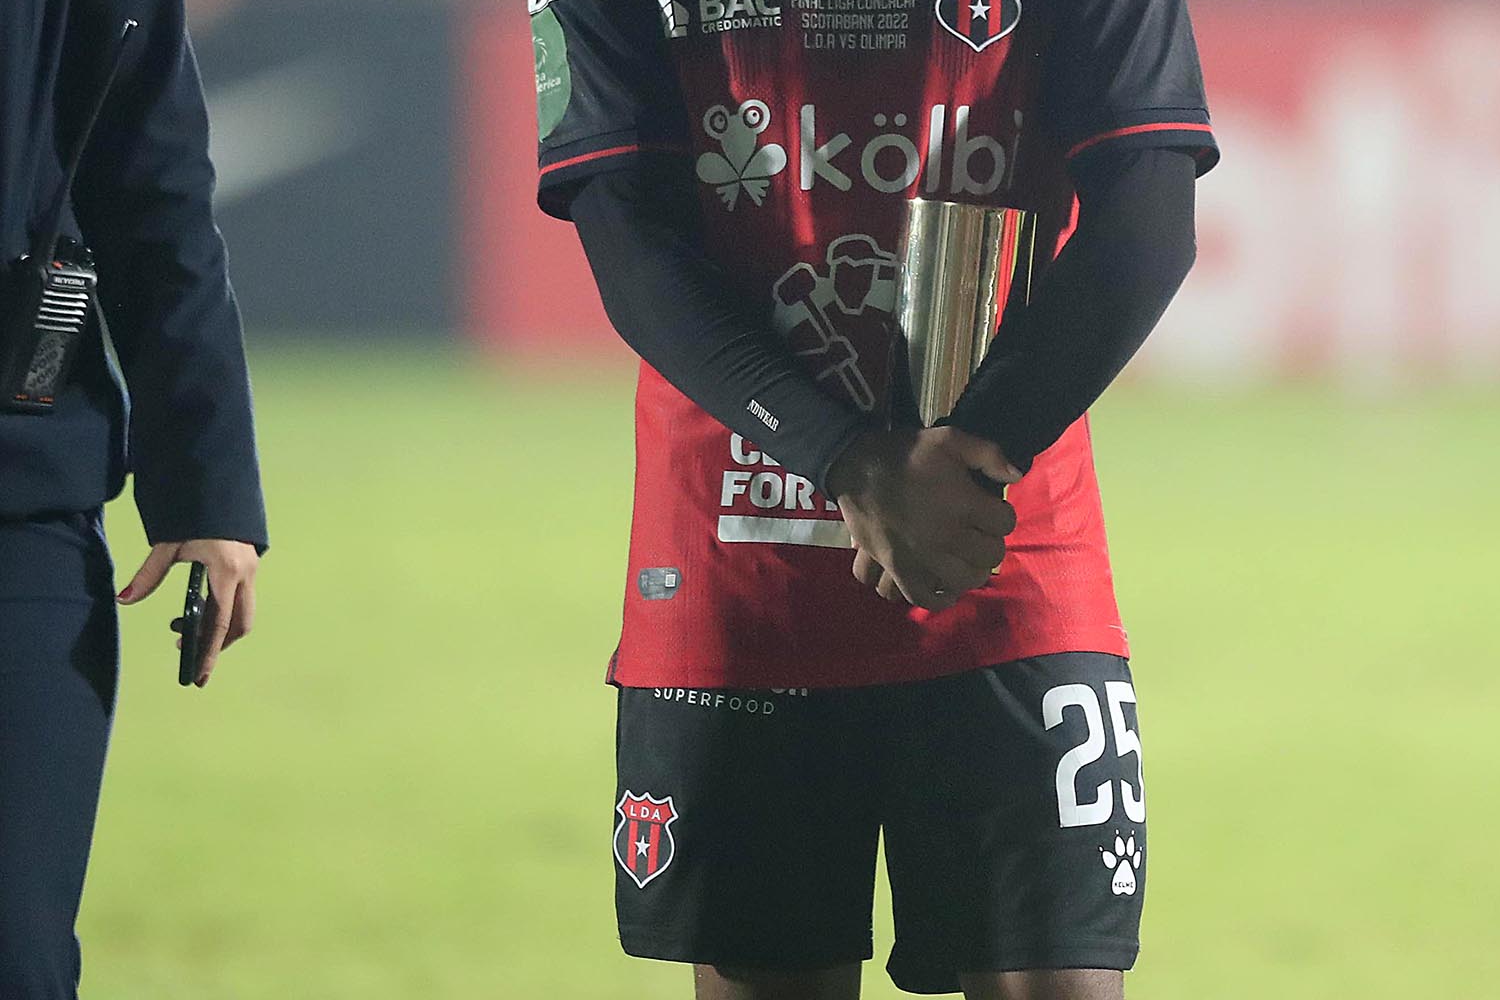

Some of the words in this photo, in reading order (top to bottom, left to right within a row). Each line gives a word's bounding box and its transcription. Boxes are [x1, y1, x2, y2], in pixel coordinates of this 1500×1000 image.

[702, 16, 782, 34] CREDOMATIC
[802, 13, 874, 29] SCOTIABANK
[877, 13, 908, 29] 2022
[839, 34, 856, 49] VS
[861, 33, 906, 49] OLIMPIA
[654, 688, 774, 714] SUPERFOOD
[1042, 681, 1146, 828] 25
[630, 804, 661, 821] LDA
